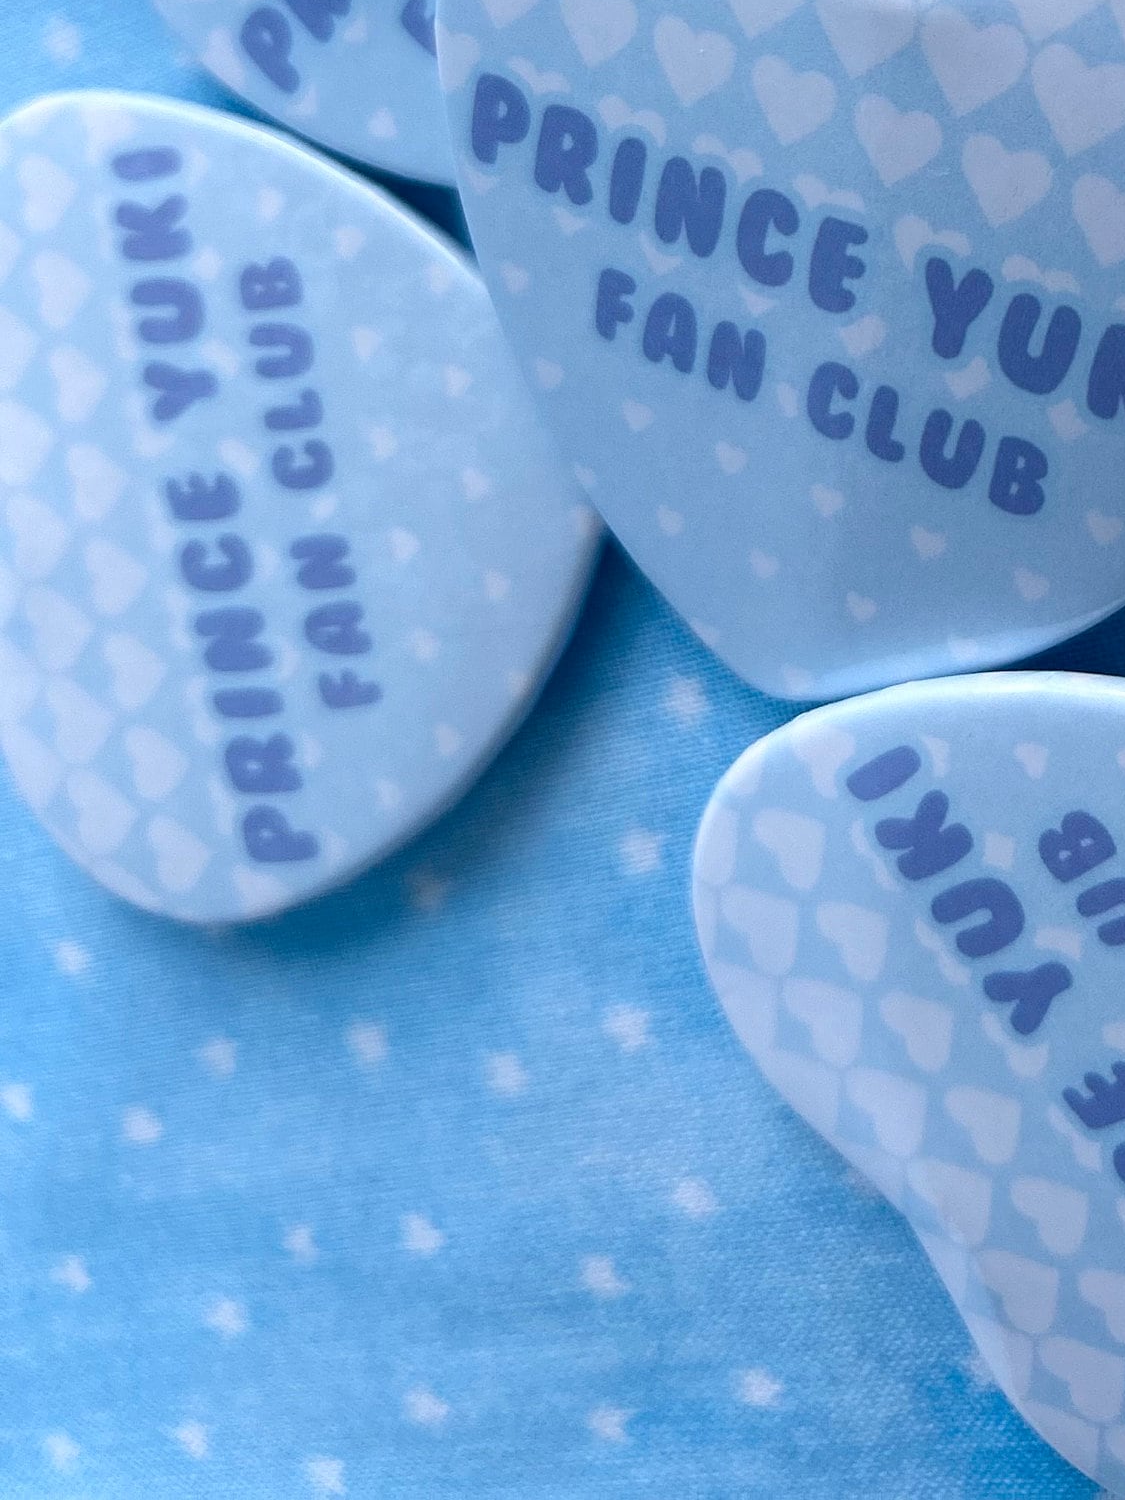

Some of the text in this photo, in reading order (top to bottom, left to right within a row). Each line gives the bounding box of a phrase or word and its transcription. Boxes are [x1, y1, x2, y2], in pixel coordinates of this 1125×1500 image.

[471, 73, 868, 312] PRINCE
[111, 145, 320, 864] PRINCE YUKI
[239, 256, 383, 709] FAN CLUB
[596, 268, 1049, 516] FAN CLUB
[846, 744, 1073, 1035] YUKI
